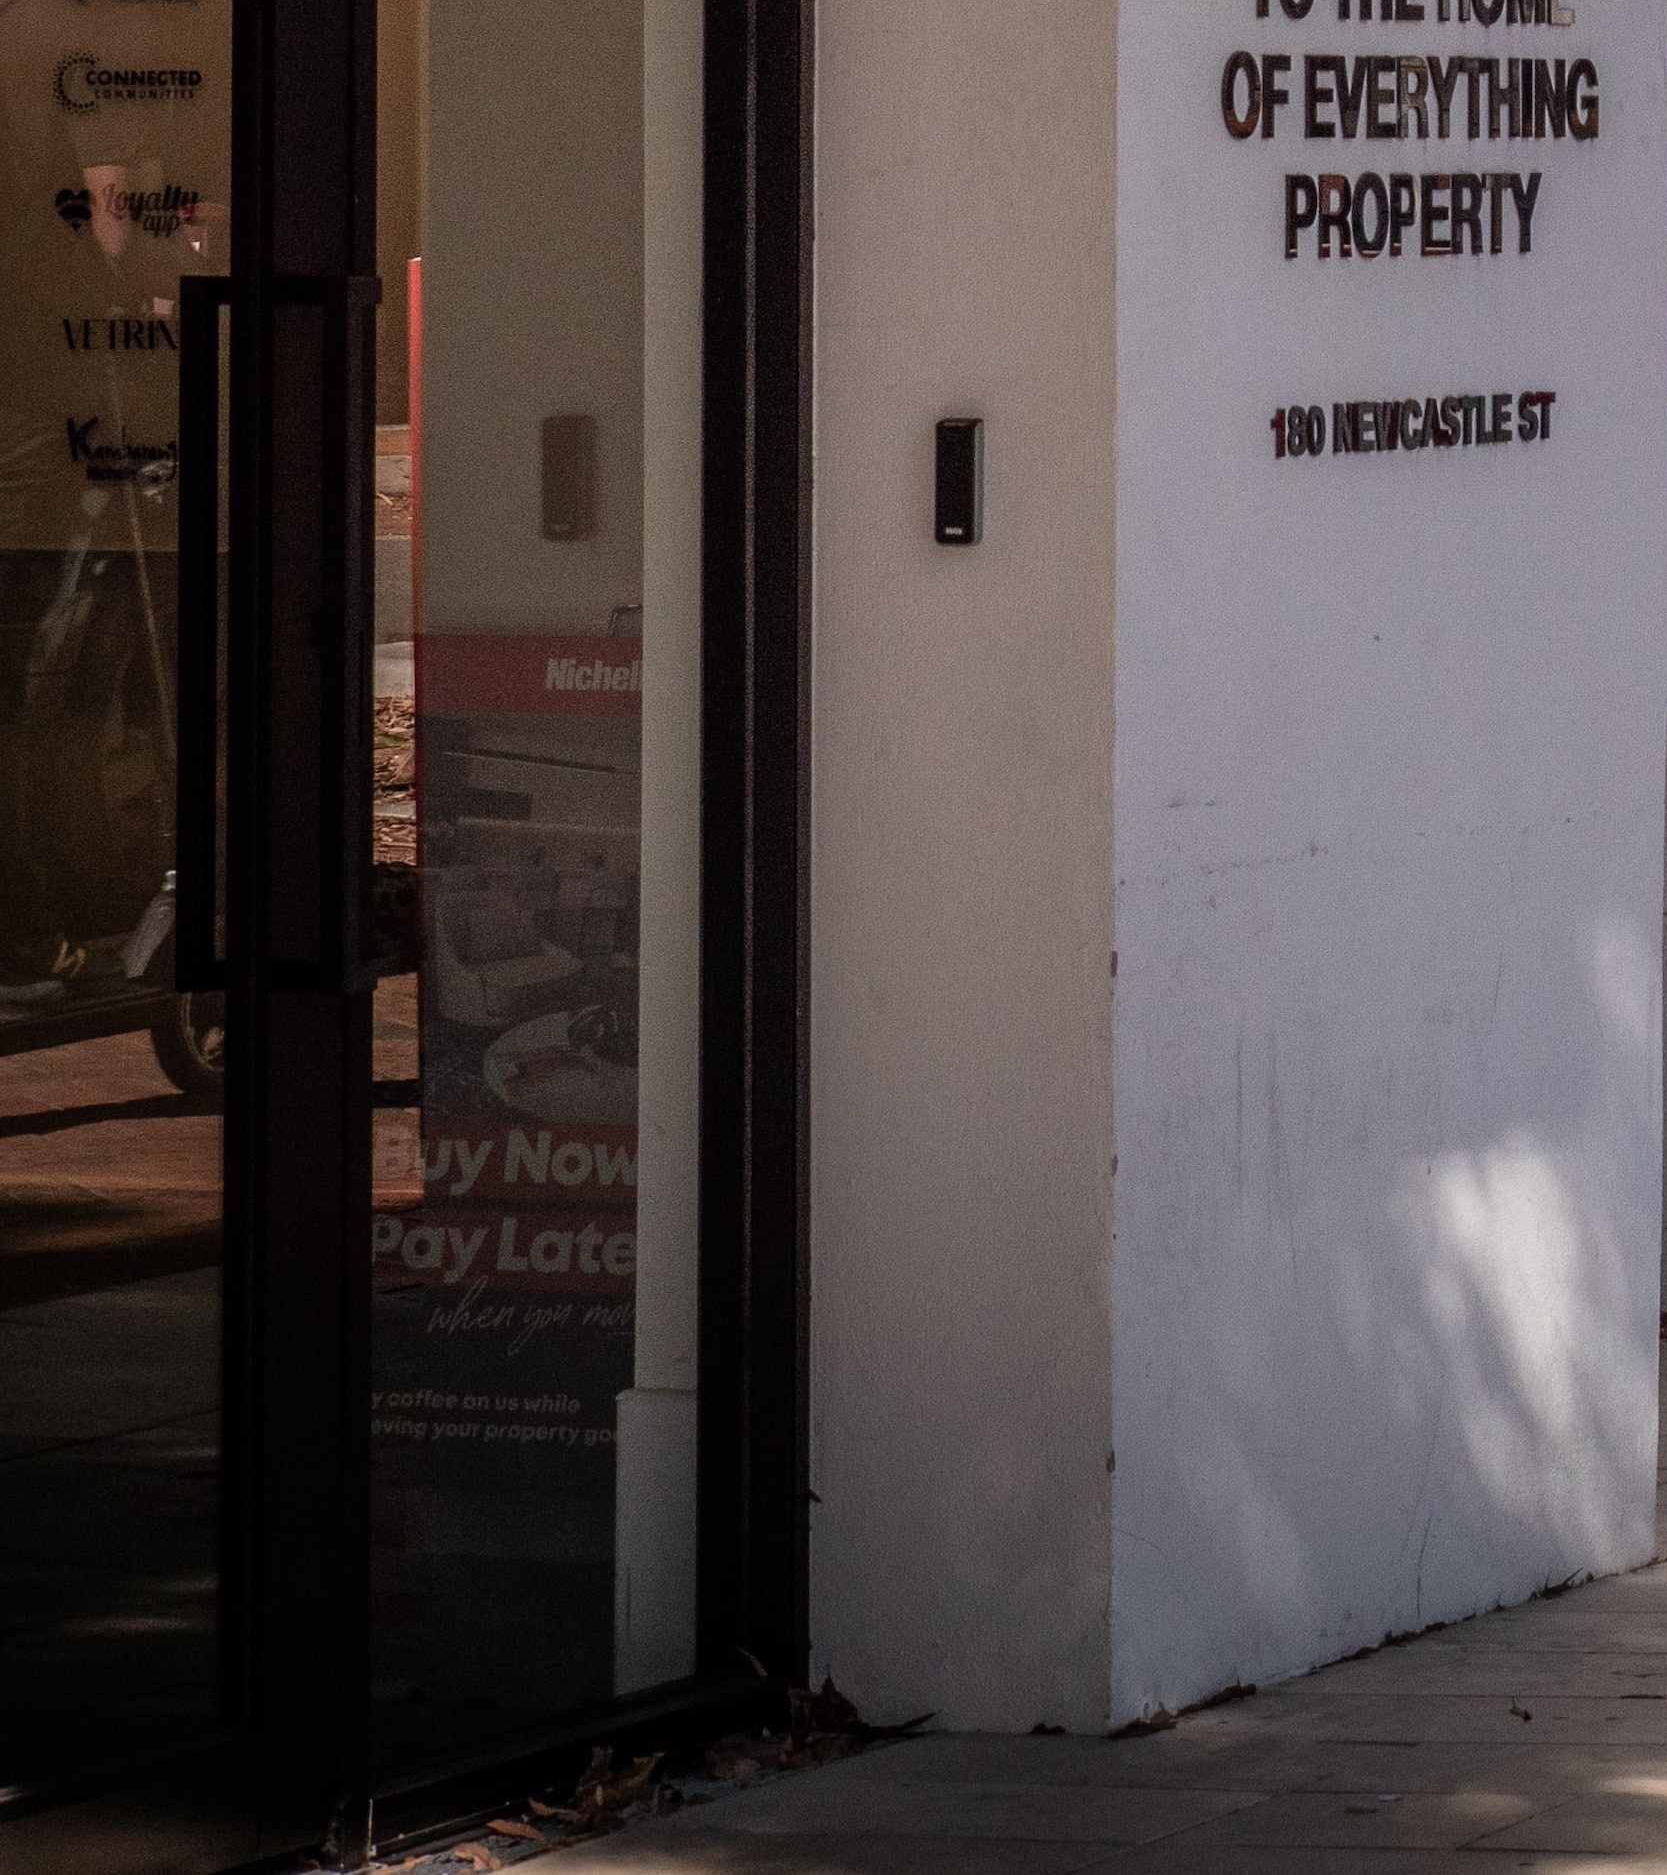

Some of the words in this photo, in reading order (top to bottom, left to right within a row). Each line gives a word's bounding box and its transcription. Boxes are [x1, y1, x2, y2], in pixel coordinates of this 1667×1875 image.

[86, 70, 202, 86] CONNECTED
[95, 89, 195, 99] COMMUNITIES
[1222, 49, 1291, 142] OF
[1304, 52, 1600, 141] EVERYTHING
[103, 183, 198, 222] Loyalty
[1284, 172, 1542, 260] PROPERTY
[1270, 405, 1326, 461] 180
[1332, 394, 1513, 455] NEWCASTLE
[1517, 391, 1556, 442] ST
[372, 1214, 489, 1284] Pay
[388, 1389, 458, 1410] coffee
[463, 1396, 492, 1412] on
[495, 1397, 519, 1412] us
[524, 1394, 581, 1414] while
[433, 1422, 481, 1440] your
[484, 1424, 579, 1445] property
